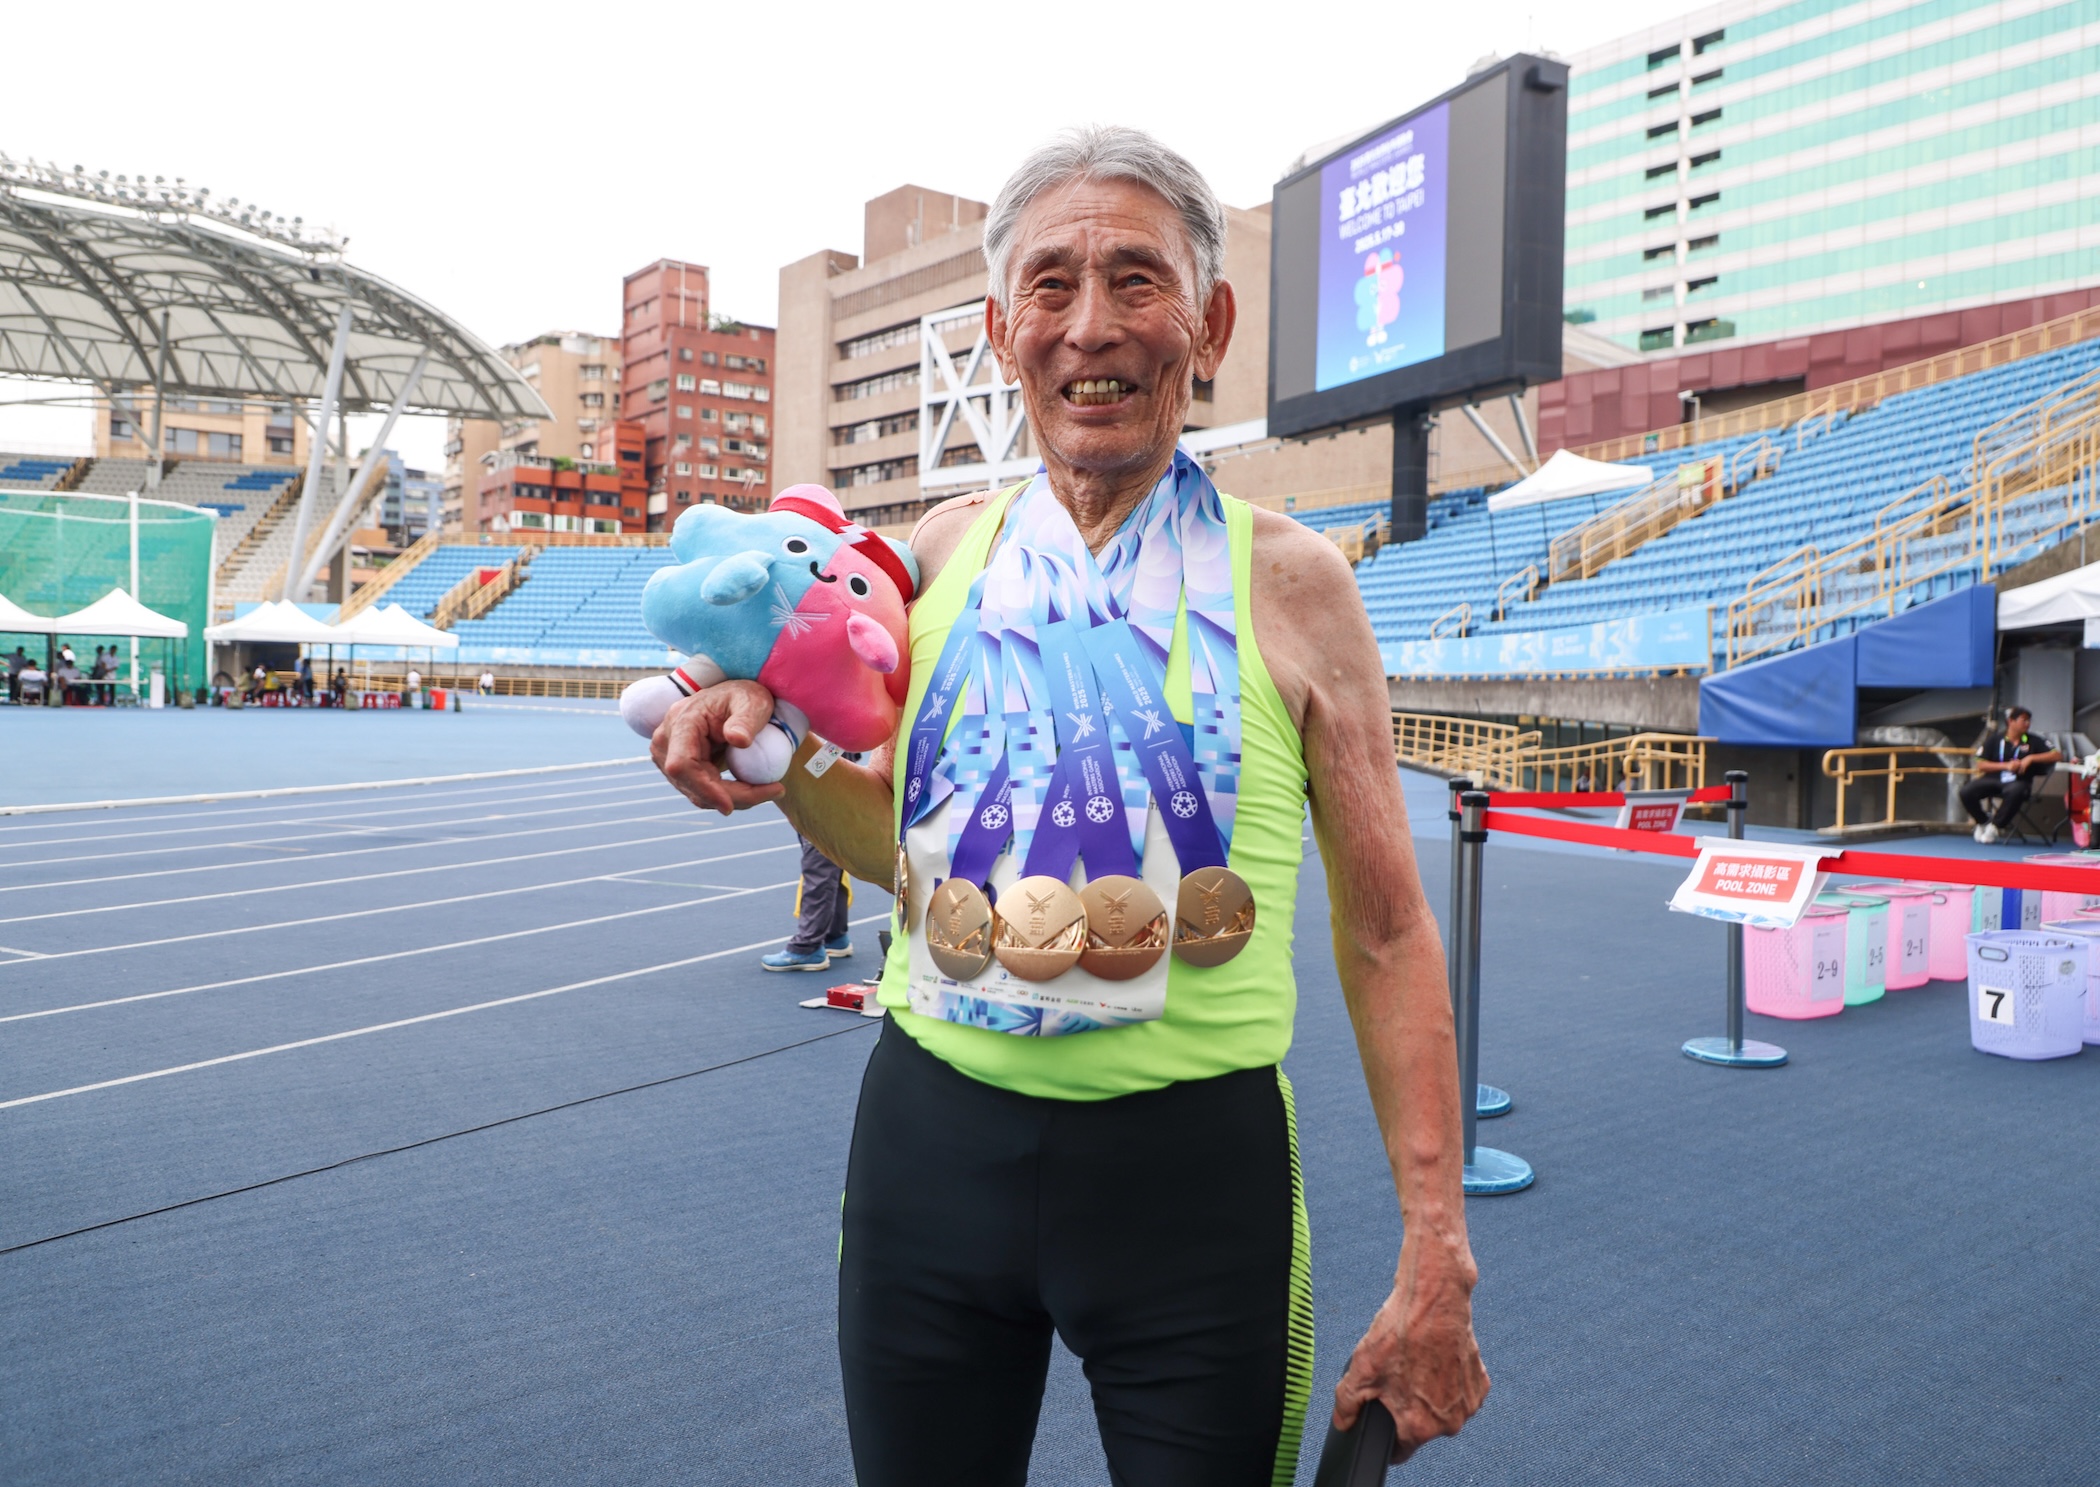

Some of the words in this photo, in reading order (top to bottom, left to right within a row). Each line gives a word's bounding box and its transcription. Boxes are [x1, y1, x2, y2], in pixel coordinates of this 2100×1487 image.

[1339, 206, 1383, 240] WELCOME
[1382, 201, 1396, 221] TO
[1395, 187, 1425, 216] TAIPEI
[1063, 652, 1071, 669] GAMES
[1114, 653, 1125, 668] GAMES
[944, 672, 957, 692] 2025
[1066, 669, 1075, 691] MASTERS
[1121, 668, 1136, 691] MASTERS
[1072, 691, 1080, 710] WORLD
[1078, 689, 1089, 708] 2025
[1132, 690, 1144, 707] WORLD
[1138, 686, 1152, 705] 2025
[1086, 755, 1095, 773] GAMES
[1161, 750, 1172, 768] GAMES
[1081, 759, 1092, 796] INTERNATIONAL
[1094, 760, 1105, 793] ASSOCIATION
[1157, 754, 1175, 791] INTERNATIONAL
[1169, 755, 1187, 788] ASSOCIATION
[1169, 767, 1181, 790] MASTERS
[1089, 772, 1098, 794] MASTERS
[1637, 820, 1652, 829] POOL
[1653, 819, 1667, 828] ZONE
[1713, 862, 1792, 882] 高需求攝影區
[1715, 879, 1744, 893] POOL
[1747, 883, 1778, 896] ZONE
[1869, 945, 1884, 967] 2-5
[1906, 938, 1924, 957] 2-1
[1817, 959, 1839, 980] 2-9
[1985, 990, 2006, 1019] 7
